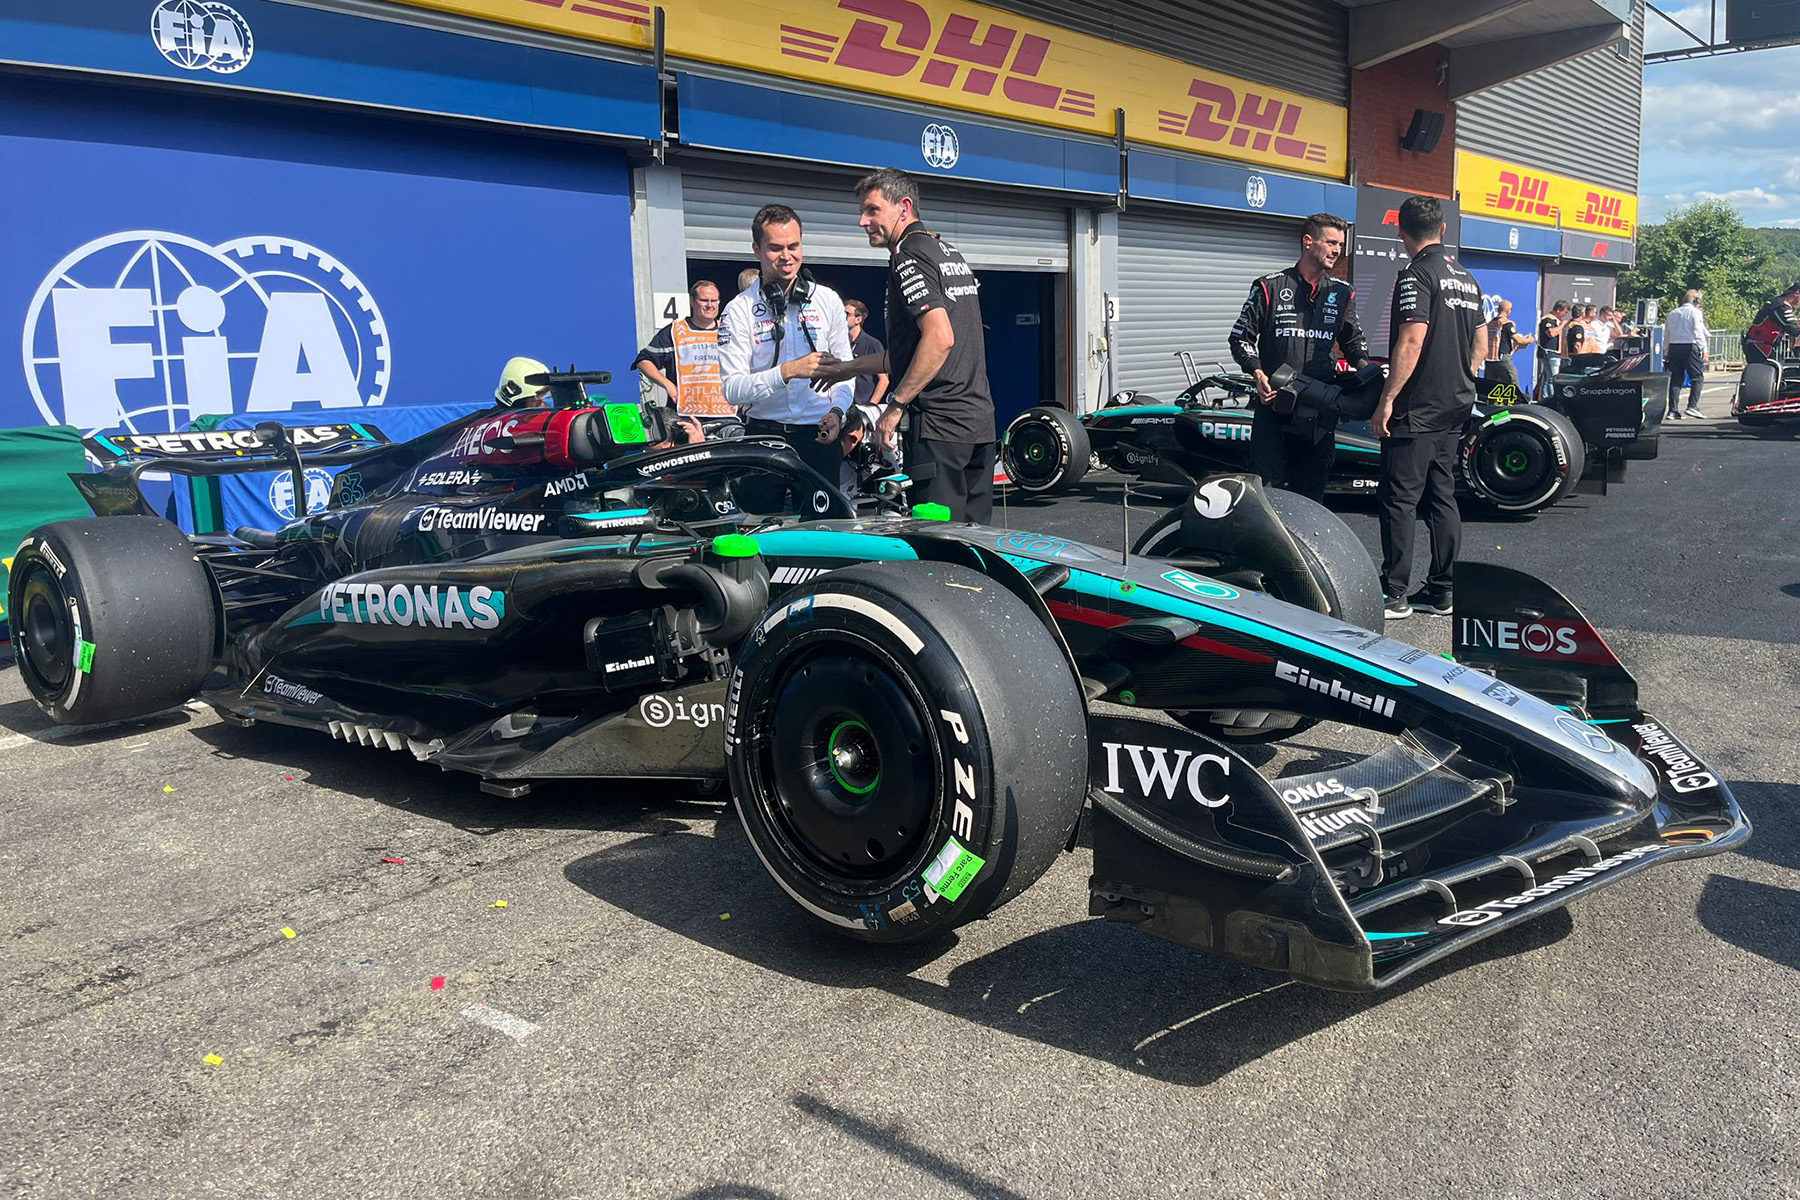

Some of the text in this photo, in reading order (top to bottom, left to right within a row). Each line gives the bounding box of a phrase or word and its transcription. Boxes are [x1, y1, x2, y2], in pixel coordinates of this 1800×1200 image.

[834, 0, 1061, 108] DHL
[1186, 79, 1306, 158] DHL
[1497, 171, 1551, 216] DHL
[1584, 192, 1622, 229] DHL
[899, 266, 916, 279] IWC
[939, 262, 973, 277] PETRON
[663, 296, 679, 319] 4
[1106, 301, 1115, 320] 3
[1275, 328, 1334, 340] PETRONAS
[705, 396, 725, 404] TIM
[1244, 386, 1258, 394] AM
[1488, 384, 1517, 405] 44
[1580, 387, 1636, 396] Snapdragon
[1146, 417, 1176, 425] AMG
[130, 426, 340, 453] PETROAS
[451, 419, 519, 457] INEOS
[642, 451, 712, 475] CROWDSTRIKE
[338, 471, 366, 508] 63
[426, 471, 471, 485] SOLERA
[544, 477, 578, 498] AMD
[438, 507, 546, 532] TeamViewer
[595, 516, 645, 529] PETRONAS
[320, 583, 500, 630] PETRONAS
[1461, 617, 1578, 655] INEOS
[605, 655, 656, 673] Einhell
[273, 678, 324, 705] TeamViewer
[1274, 659, 1398, 718] Einhell
[725, 665, 744, 756] PIRELLI
[940, 709, 970, 744] P
[1632, 723, 1700, 779] TeamViewer
[1102, 742, 1230, 808] IWC
[1282, 778, 1345, 804] ONAS
[1300, 807, 1373, 840] tium
[957, 854, 973, 872] Parc
[939, 871, 960, 893] Ferme
[1474, 844, 1670, 911] TeamViewer
